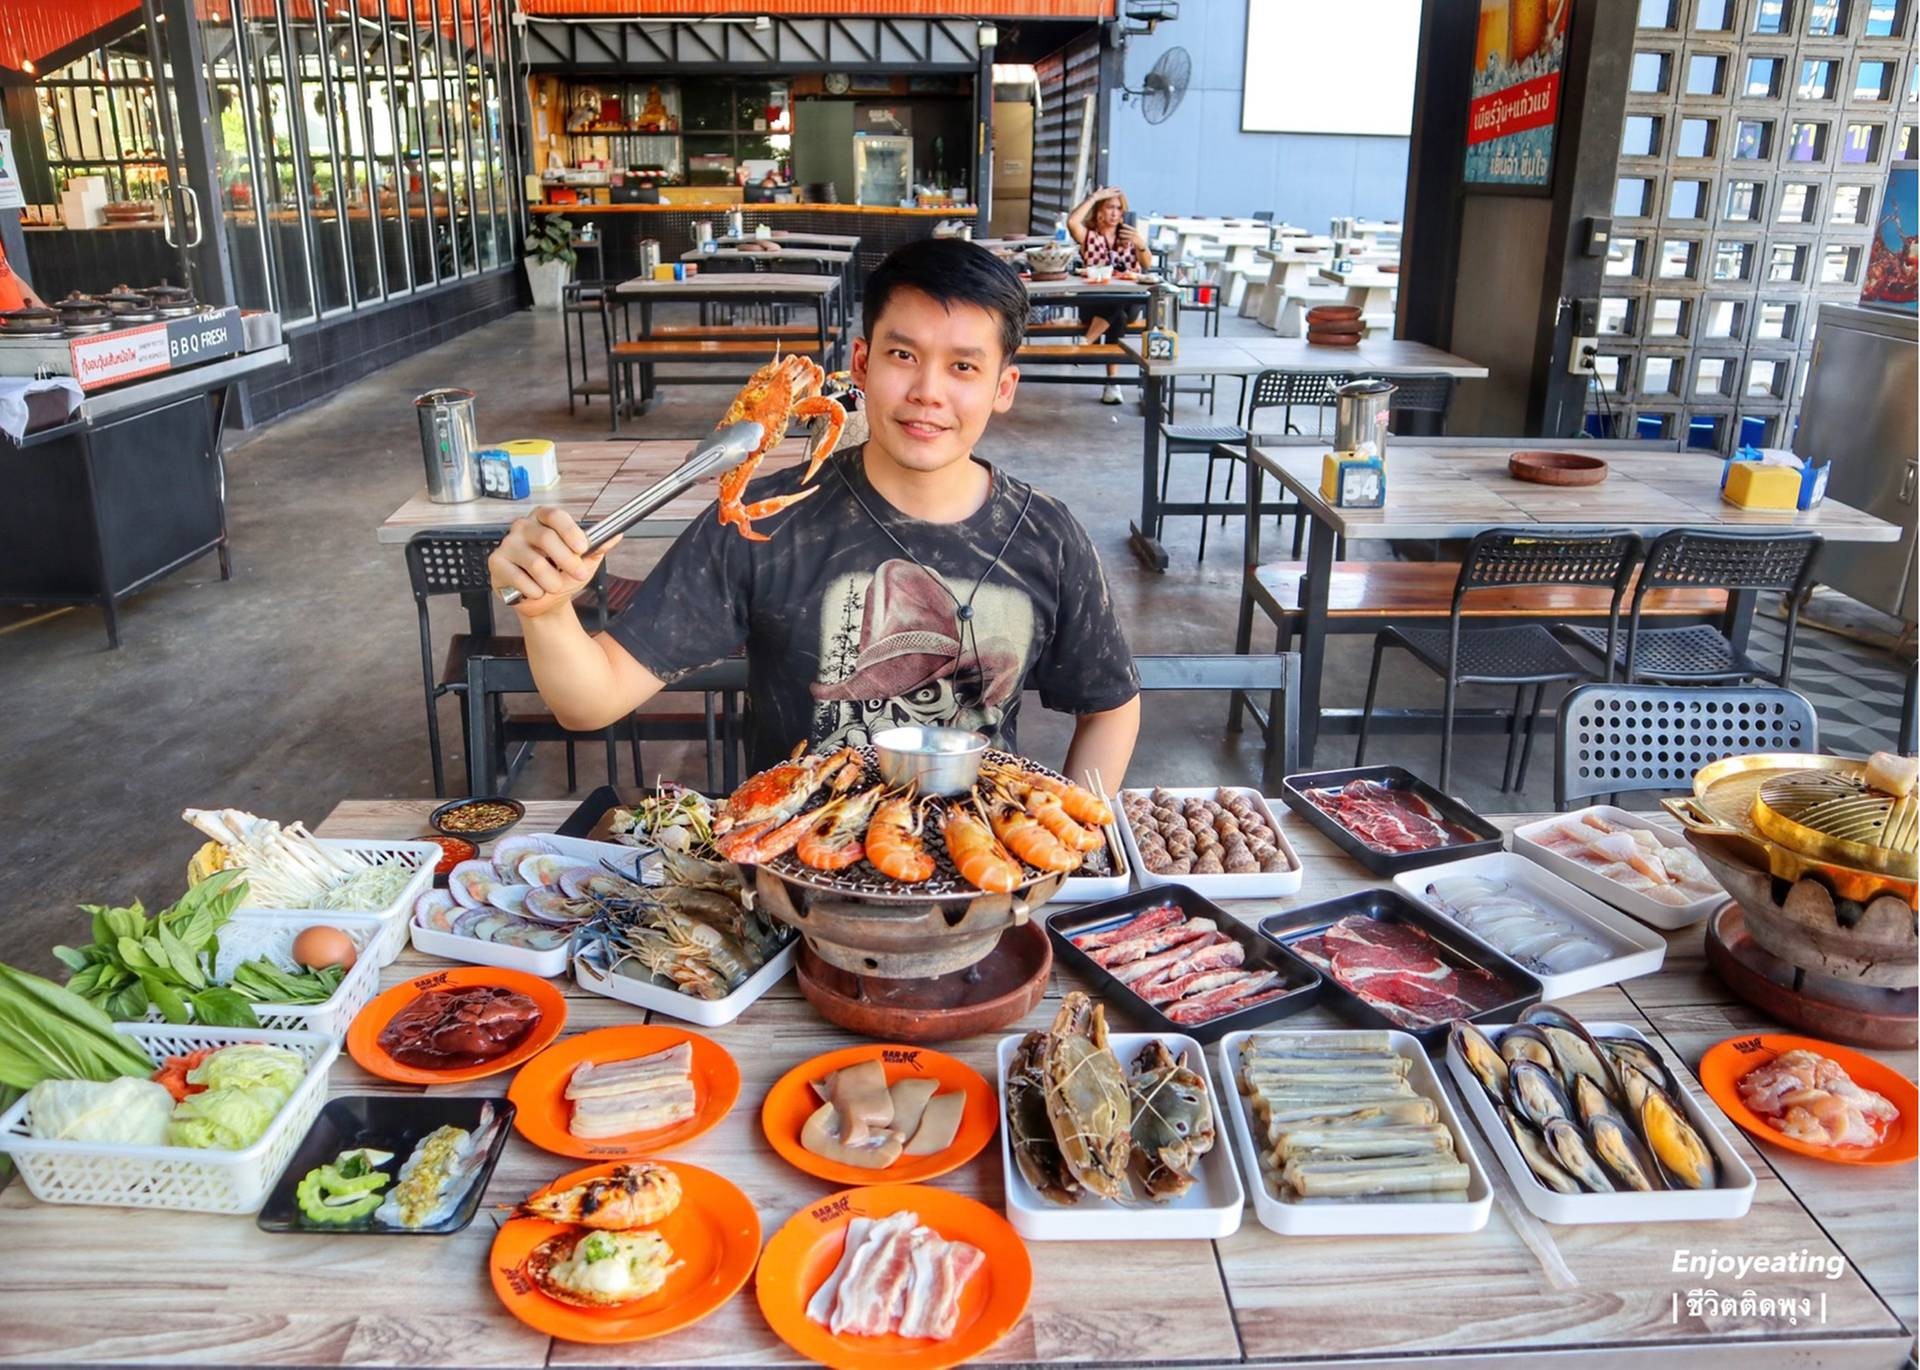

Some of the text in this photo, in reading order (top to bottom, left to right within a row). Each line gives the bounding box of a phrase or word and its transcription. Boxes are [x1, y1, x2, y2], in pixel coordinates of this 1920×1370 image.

[1474, 82, 1552, 132] เบียร์วุ้น+แก้วแช่
[200, 326, 228, 349] FRESH
[1150, 340, 1171, 357] 52
[484, 463, 510, 493] 53
[1343, 474, 1380, 500] 54
